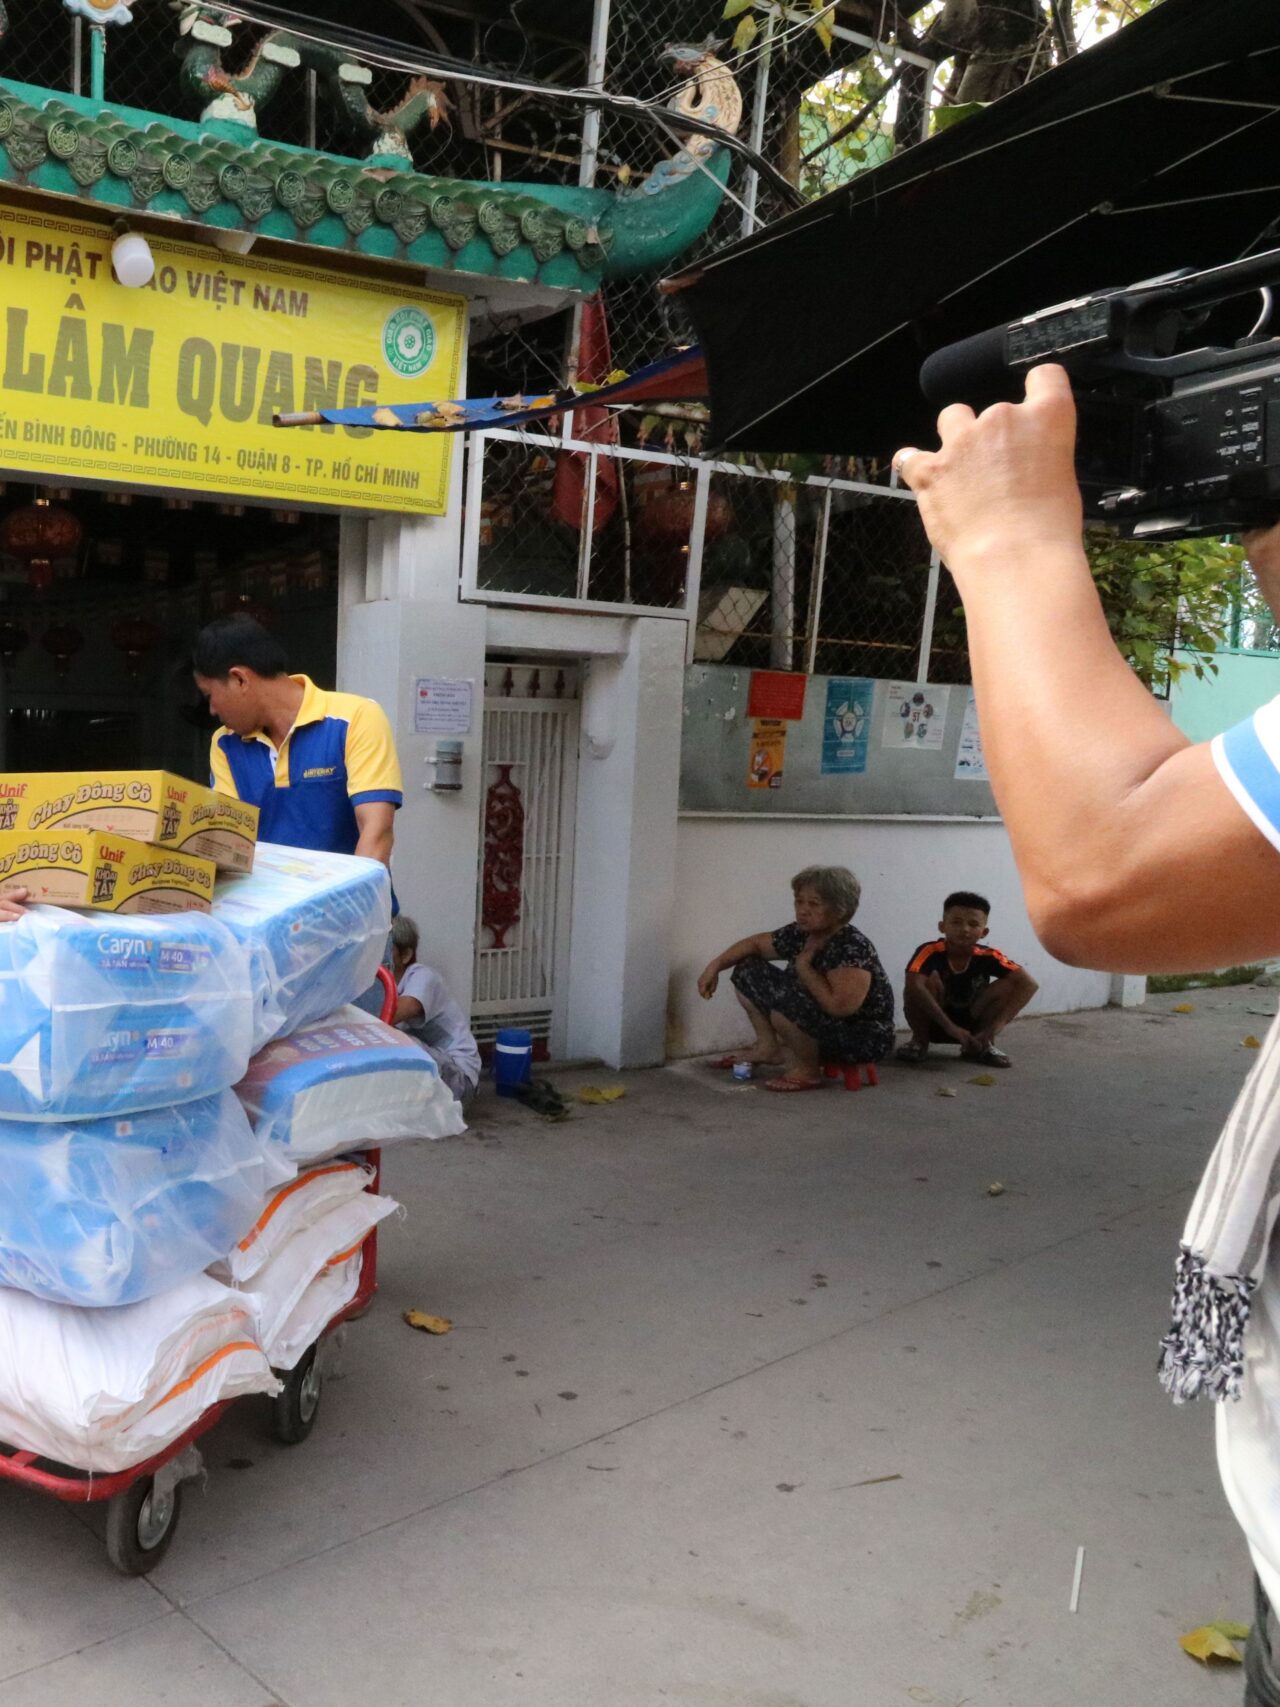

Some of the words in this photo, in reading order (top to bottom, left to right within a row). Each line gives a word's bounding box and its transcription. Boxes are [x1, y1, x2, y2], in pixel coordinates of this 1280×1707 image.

[25, 242, 103, 286] PHẬT
[186, 269, 246, 311] VIỆT
[253, 283, 309, 318] NAM
[2, 292, 154, 409] LÂM
[176, 336, 380, 440] QUANG
[23, 417, 65, 446] BÌNH
[70, 425, 117, 452] ĐÔNG
[203, 443, 220, 465] 14
[236, 449, 277, 475] QUẬN
[281, 454, 291, 474] 8
[305, 456, 327, 479] TP.
[354, 461, 379, 485] CHÍ
[382, 465, 420, 489] MINH
[28, 794, 75, 830] Chay
[100, 845, 126, 864] Unif
[97, 932, 146, 960] Caryn
[171, 951, 184, 962] 40
[147, 1039, 158, 1050] M
[159, 1037, 175, 1049] 40
